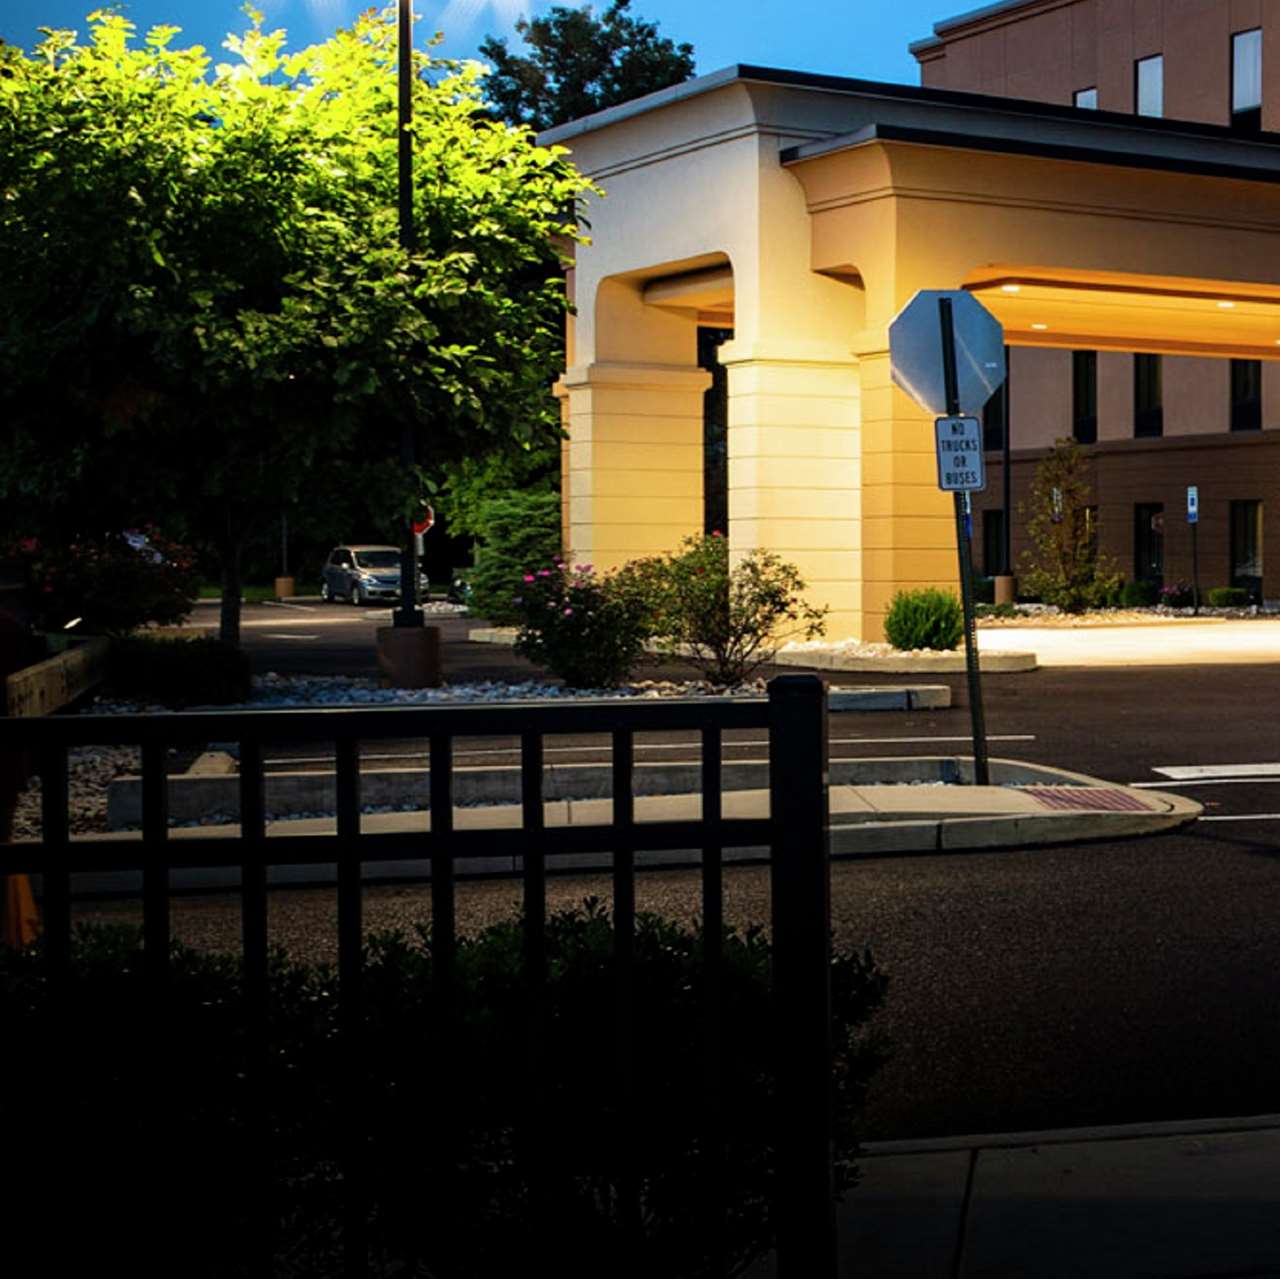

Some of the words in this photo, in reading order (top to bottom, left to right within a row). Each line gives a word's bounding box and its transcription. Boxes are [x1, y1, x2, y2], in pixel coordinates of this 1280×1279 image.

[941, 439, 978, 453] TRUCKS
[953, 455, 967, 468] OR
[945, 472, 977, 485] BUSES
